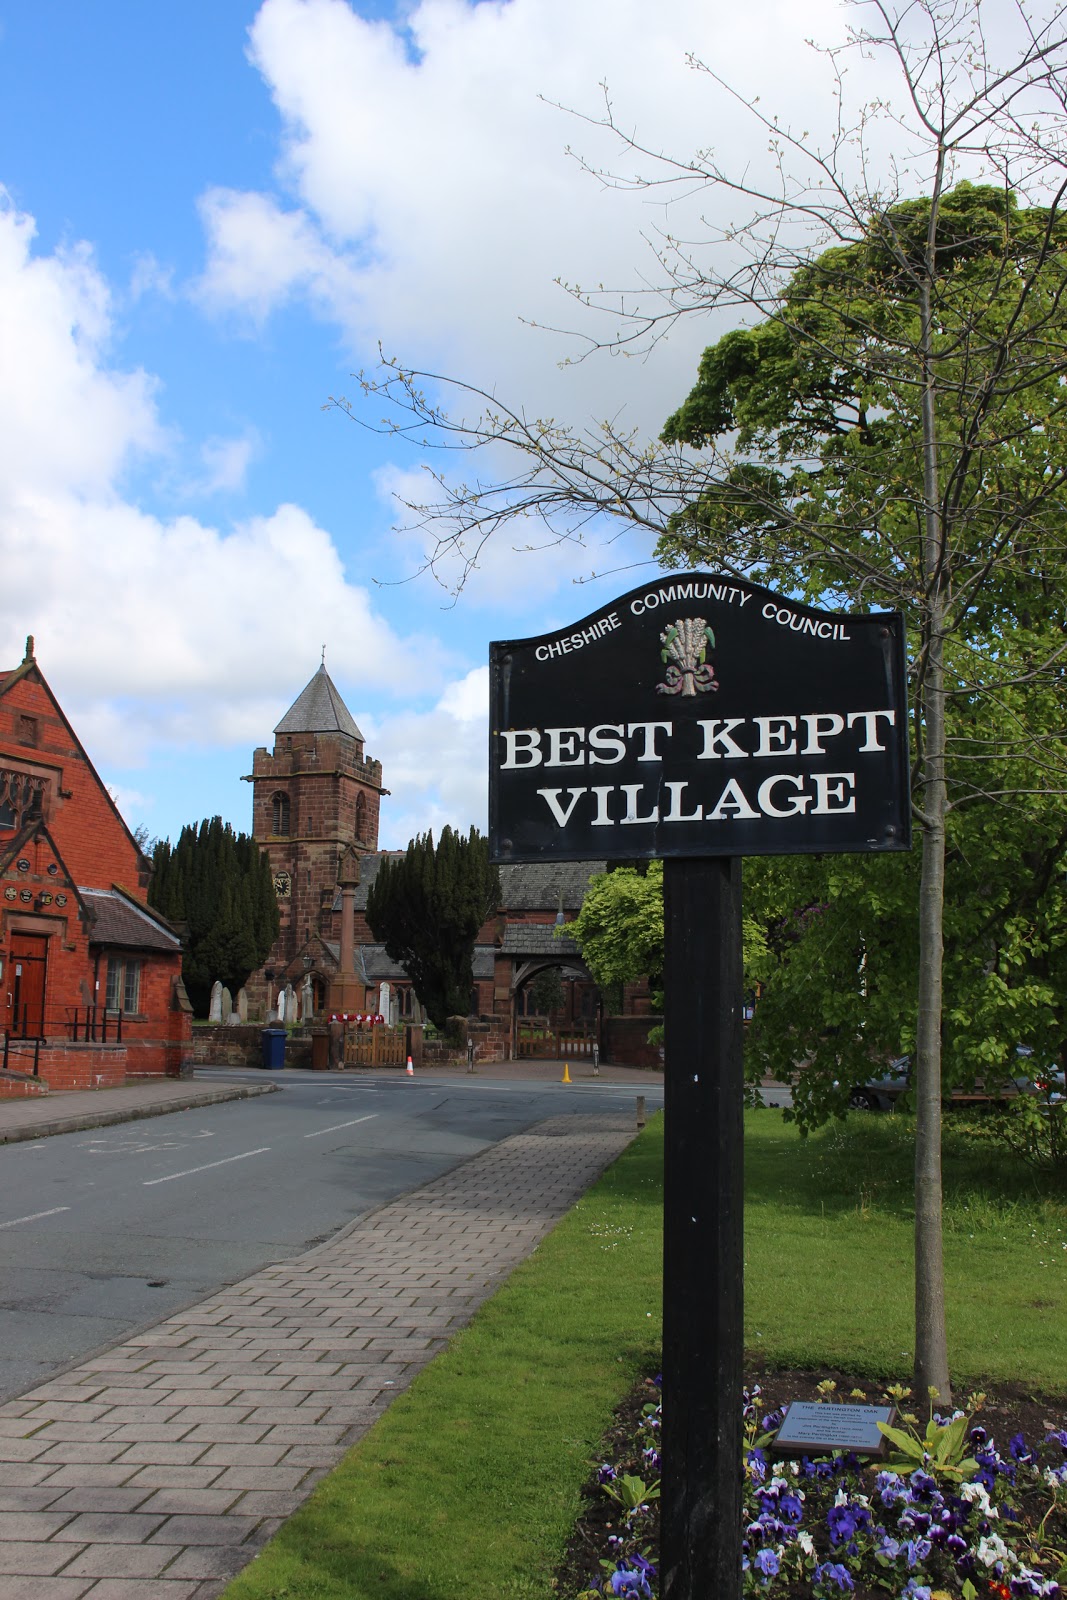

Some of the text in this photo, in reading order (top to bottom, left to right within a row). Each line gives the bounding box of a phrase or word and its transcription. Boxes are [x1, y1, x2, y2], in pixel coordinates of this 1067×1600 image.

[535, 583, 851, 662] CHESHIRE COMMUNITY COUNCIL
[500, 710, 894, 769] BEST KEPT
[537, 773, 855, 827] VILLAGE
